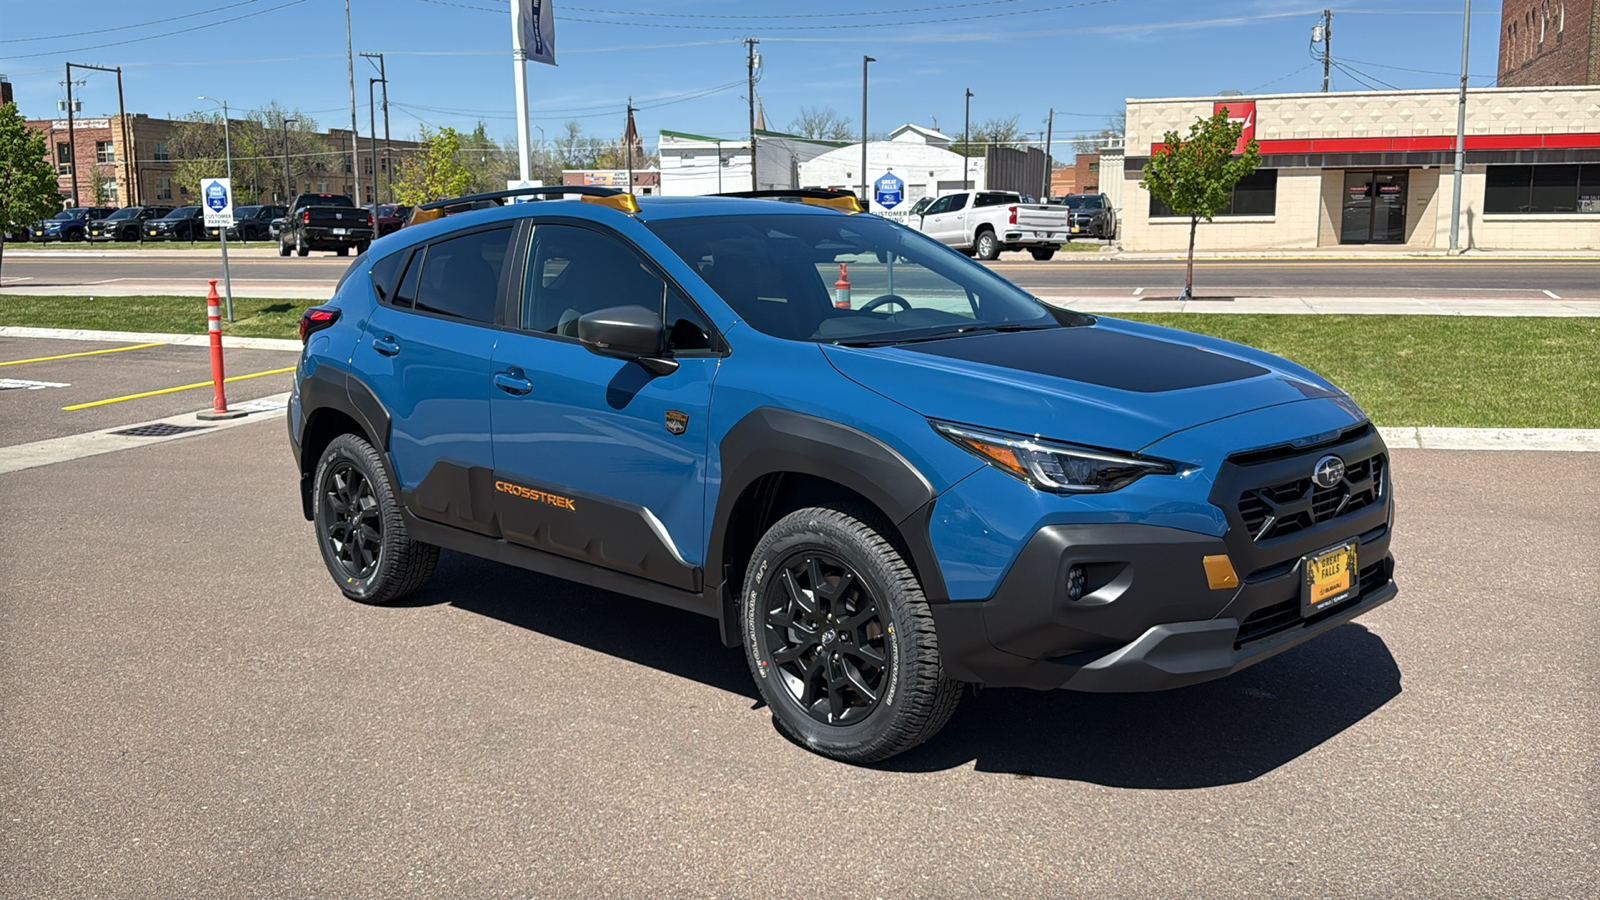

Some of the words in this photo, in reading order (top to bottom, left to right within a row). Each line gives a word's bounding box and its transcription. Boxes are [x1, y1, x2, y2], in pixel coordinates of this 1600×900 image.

[495, 480, 576, 511] CROSSTREK
[1321, 553, 1341, 568] GREAT
[1321, 563, 1341, 580] FALLS
[748, 590, 767, 679] GEOLANDAR
[885, 621, 899, 706] YOKOHAMA
